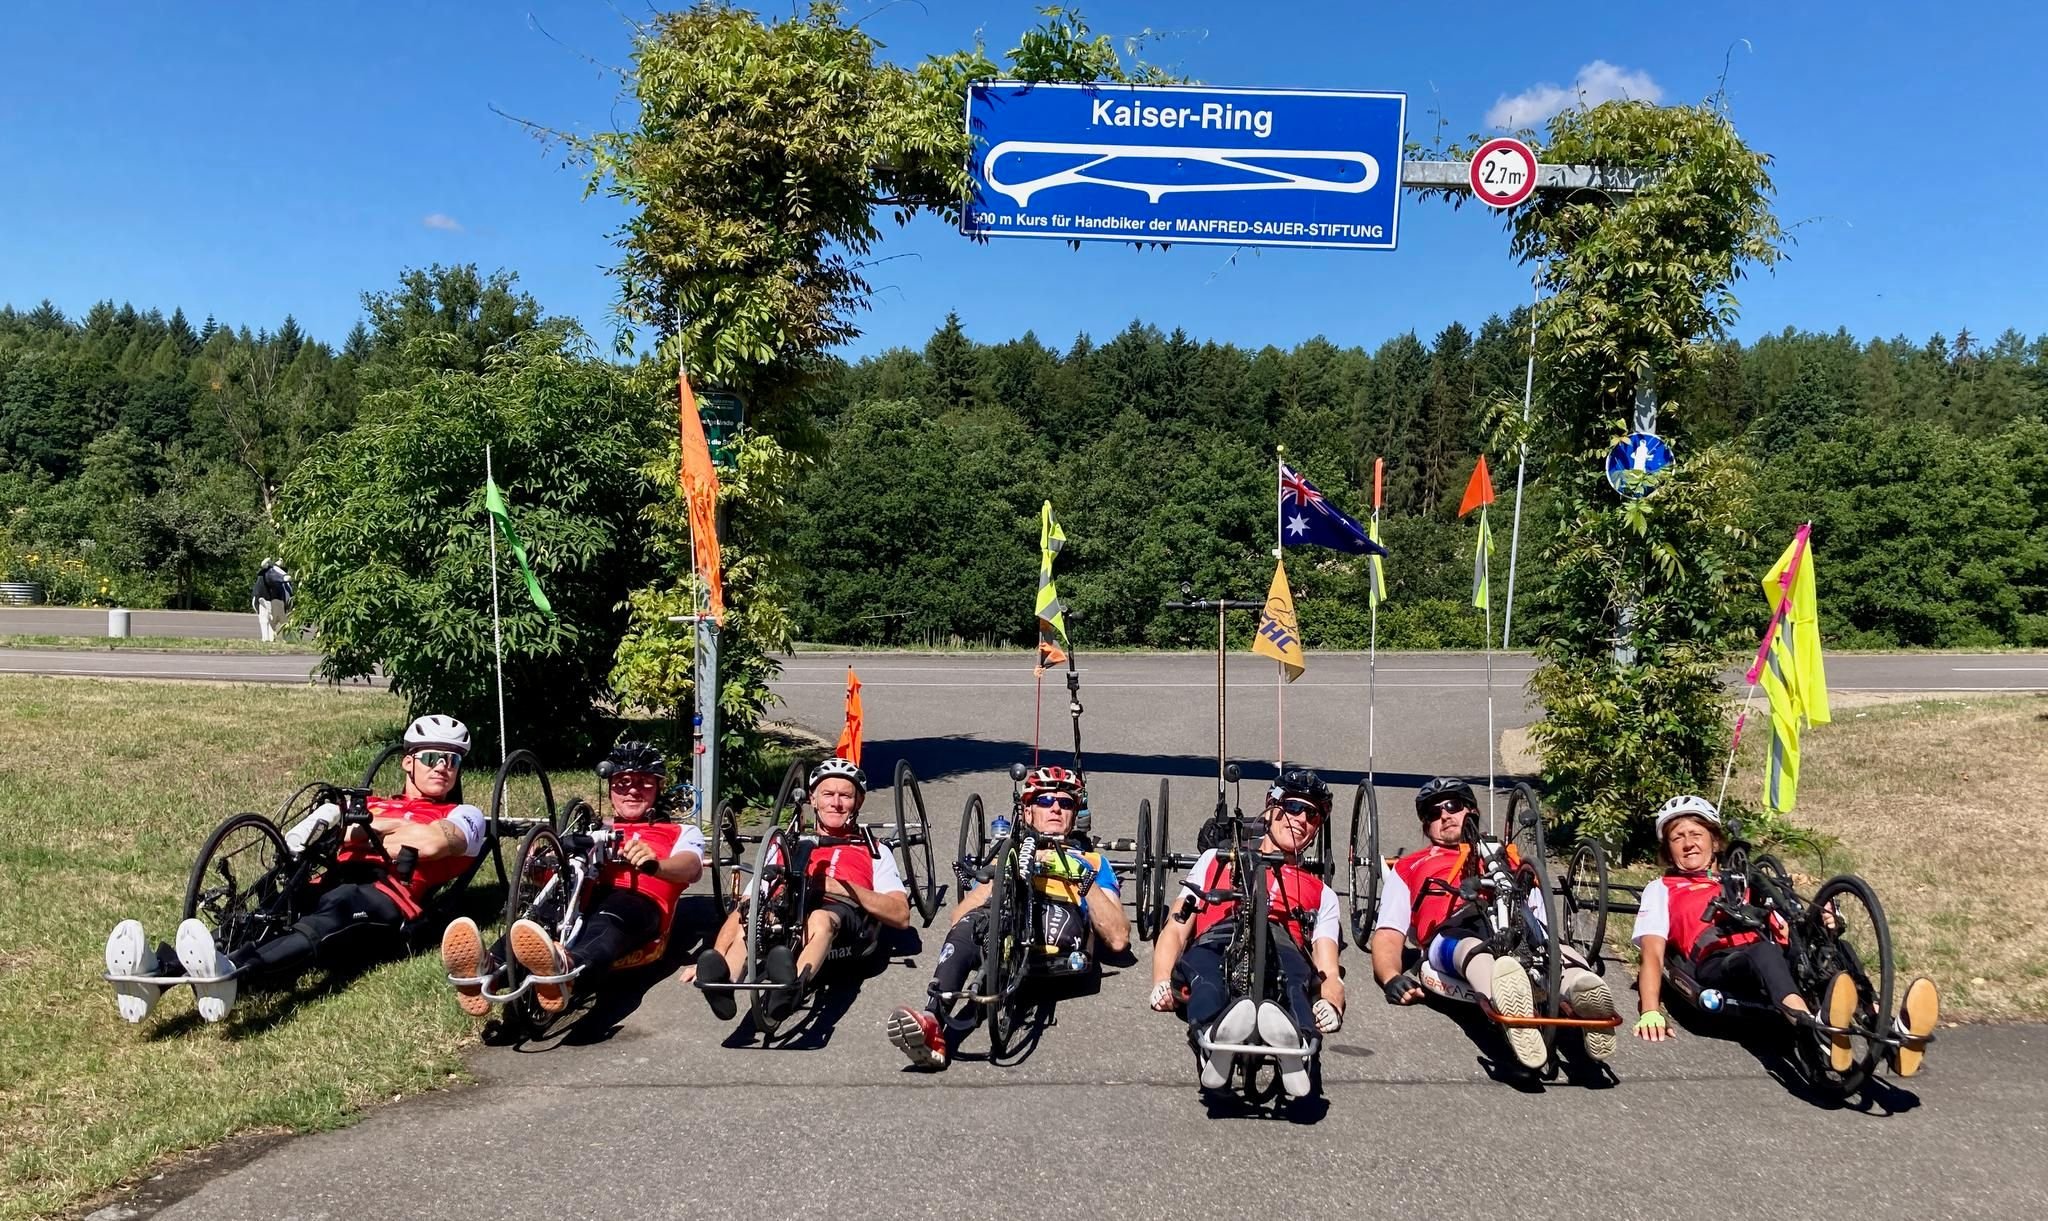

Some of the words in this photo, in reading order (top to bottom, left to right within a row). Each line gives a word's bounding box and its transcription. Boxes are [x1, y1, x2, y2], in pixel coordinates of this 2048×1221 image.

[1092, 99, 1272, 138] Kaiser-Ring
[1000, 215, 1012, 225] m
[1017, 213, 1048, 226] Kurs
[1052, 214, 1072, 227] für
[1075, 215, 1146, 230] Handbiker
[1149, 218, 1172, 231] der
[1176, 218, 1383, 238] MANFRED-SAUER-STIFTUNG
